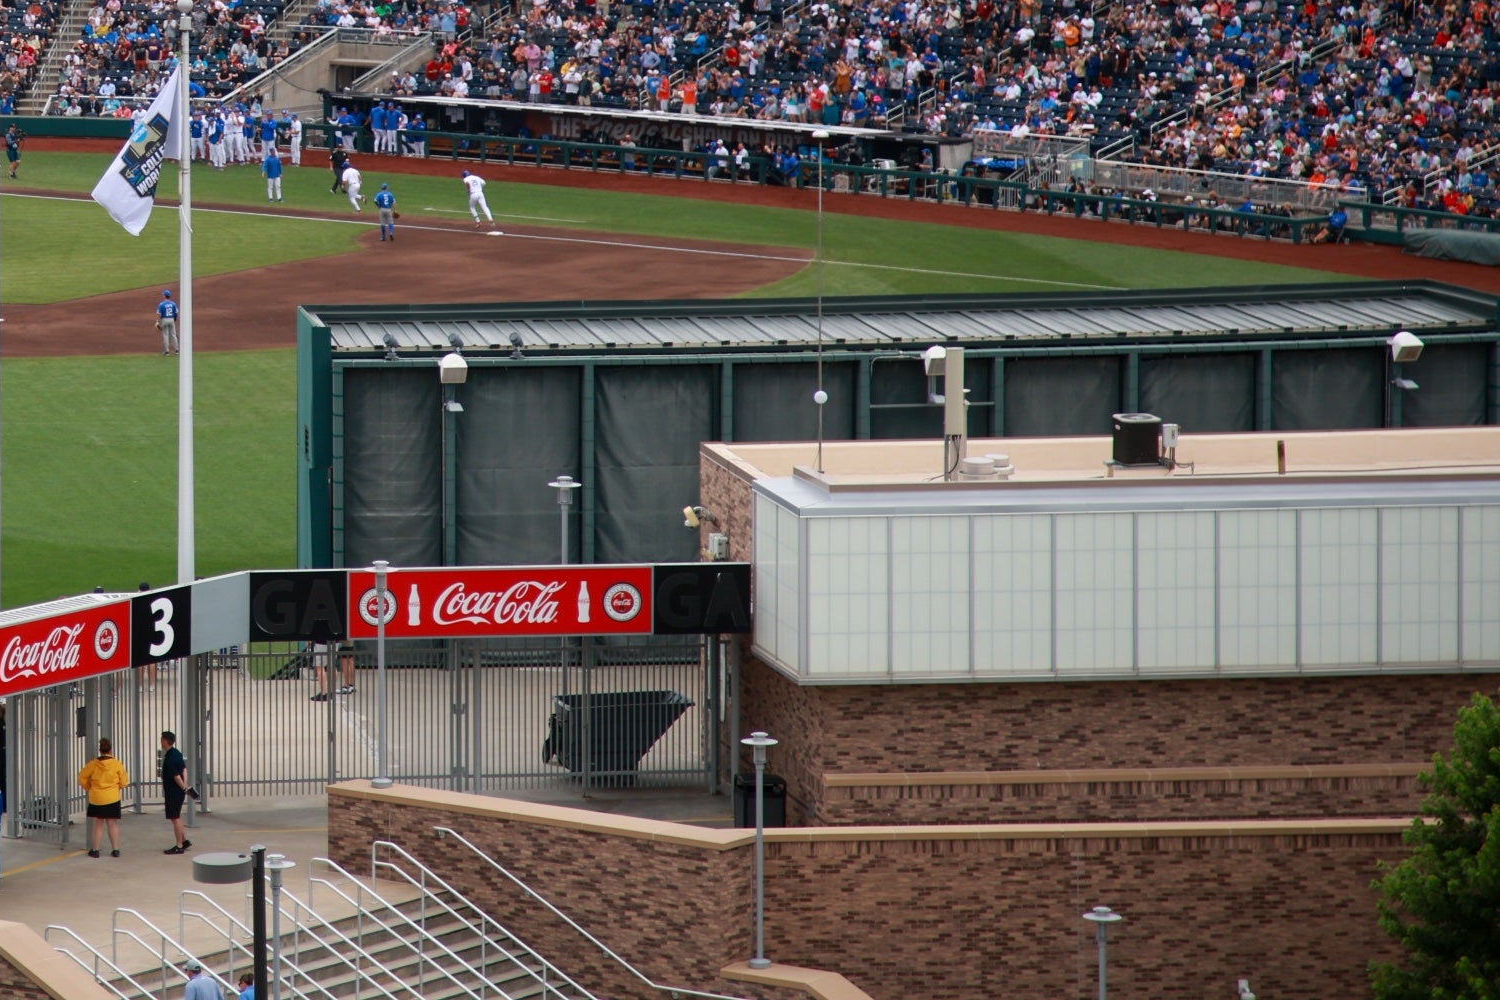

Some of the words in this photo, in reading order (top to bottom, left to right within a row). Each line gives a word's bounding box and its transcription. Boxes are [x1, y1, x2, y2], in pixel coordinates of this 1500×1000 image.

[137, 164, 162, 196] WORL
[140, 143, 166, 176] COLLE
[432, 581, 566, 625] Coca-Cola
[149, 597, 175, 657] 3
[0, 622, 86, 683] Coca-Cola
